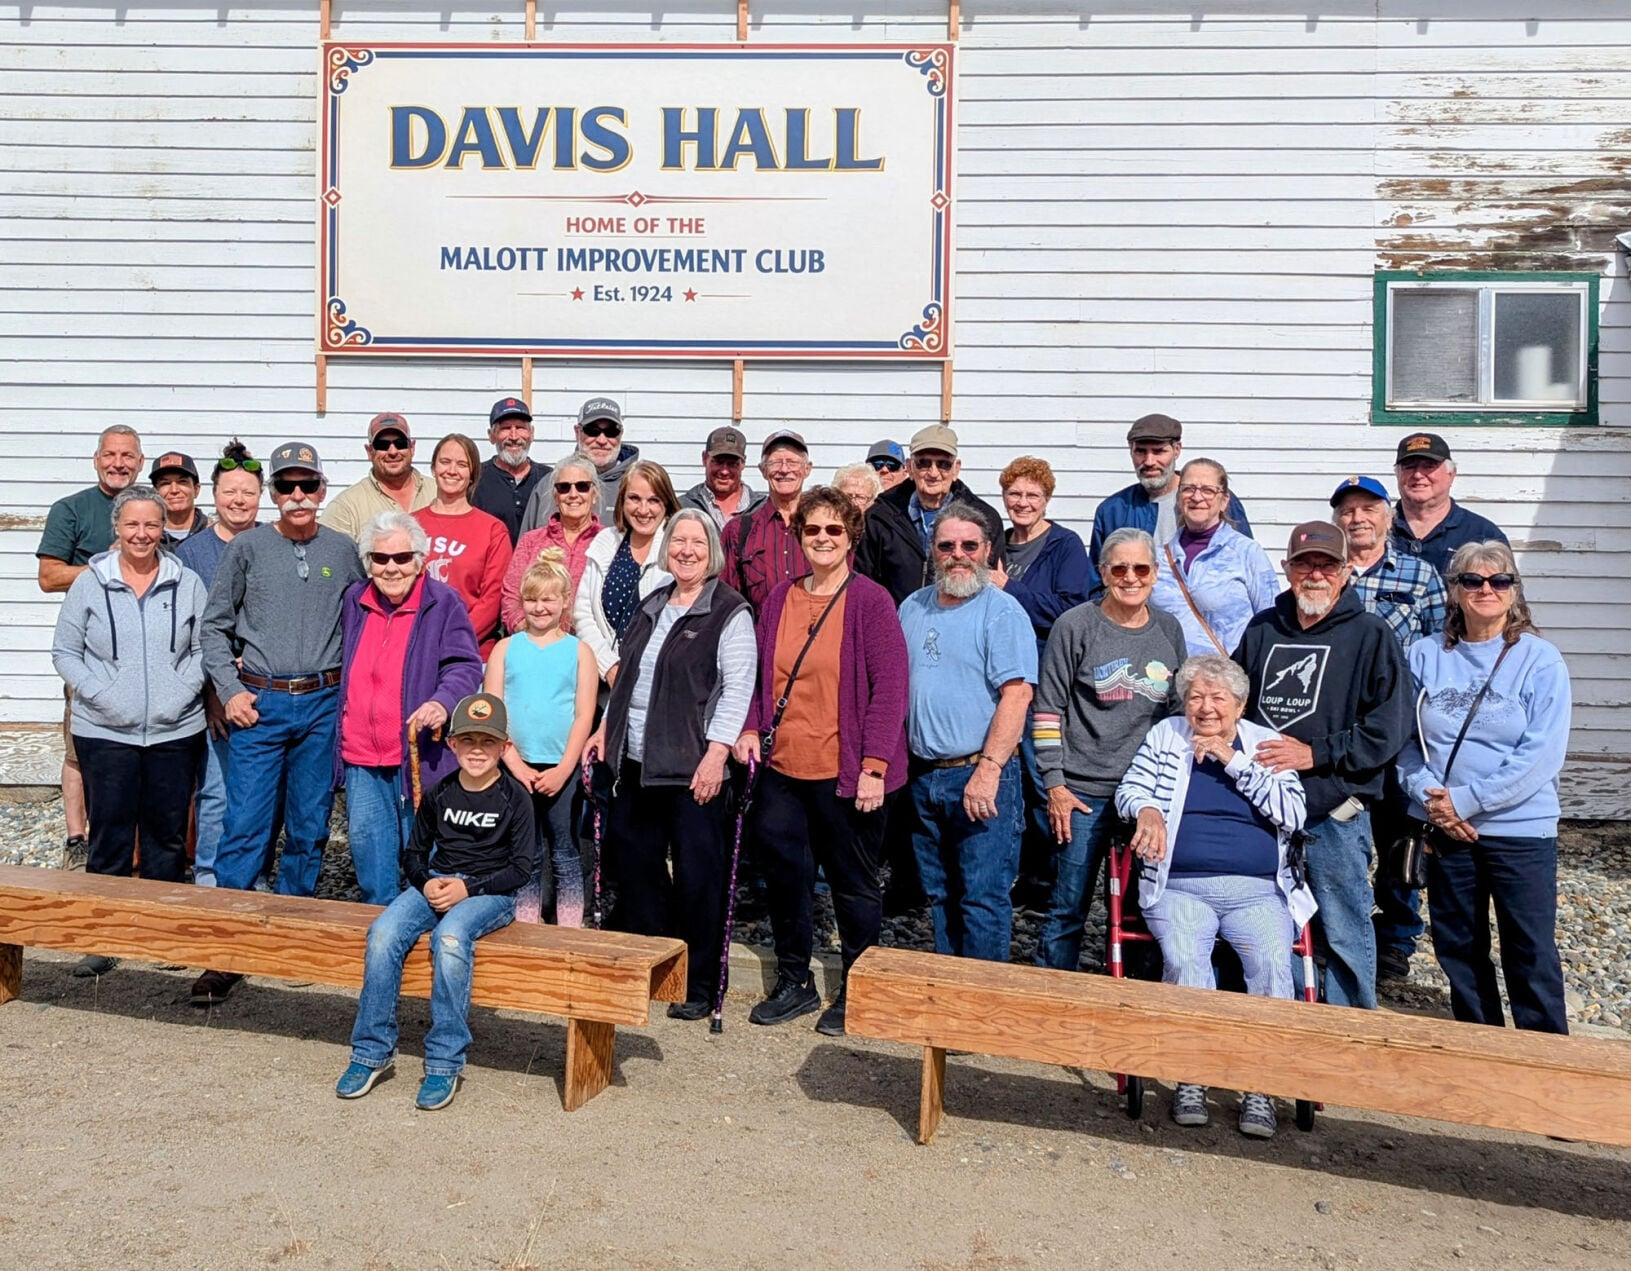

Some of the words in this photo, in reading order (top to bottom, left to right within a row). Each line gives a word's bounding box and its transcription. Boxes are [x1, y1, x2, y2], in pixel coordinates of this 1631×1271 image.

[389, 105, 634, 173] DAVIS
[660, 107, 886, 172] HALL
[566, 217, 626, 234] HOME
[633, 217, 661, 234] OF
[667, 217, 705, 234] THE
[440, 246, 548, 272] MALOTT
[557, 247, 747, 273] IMPROVEMENT
[755, 248, 825, 274] CLUB
[593, 284, 625, 302] Est.
[630, 285, 673, 303] 1924
[1261, 695, 1284, 705] LOUP
[1286, 697, 1312, 707] LOUP
[443, 807, 500, 827] NIKE
